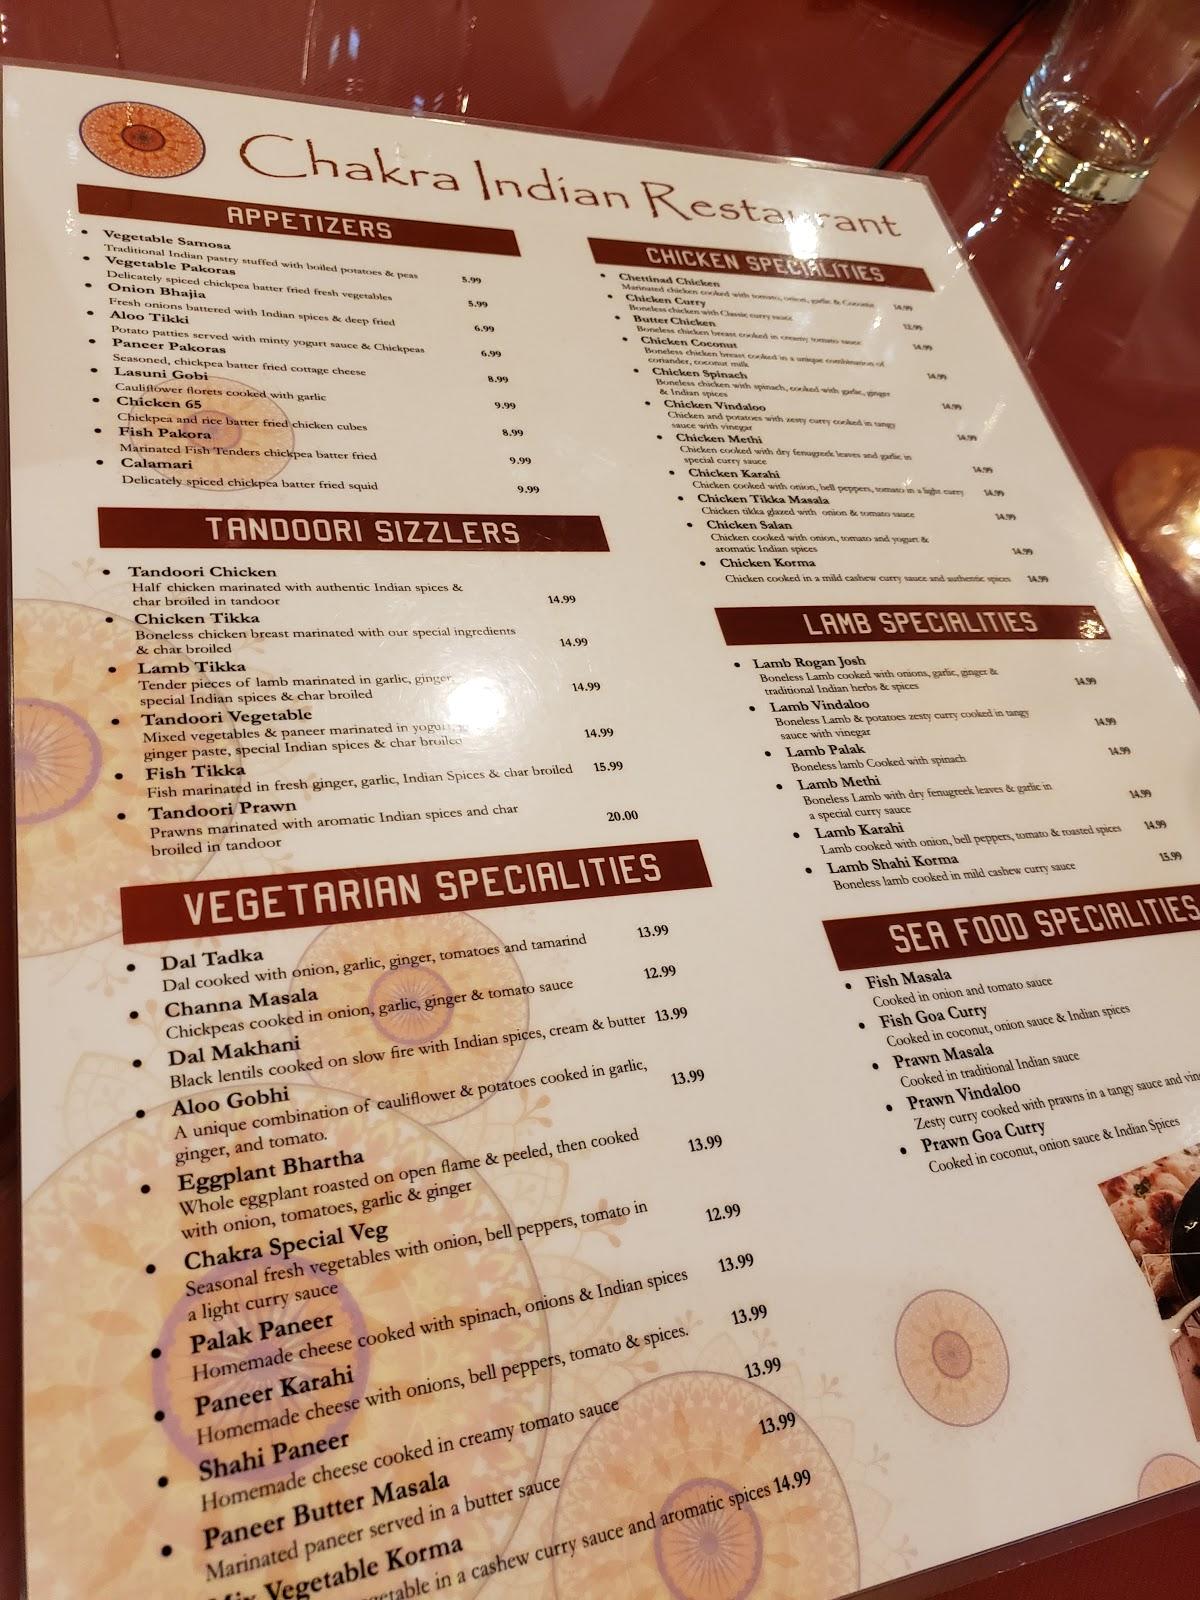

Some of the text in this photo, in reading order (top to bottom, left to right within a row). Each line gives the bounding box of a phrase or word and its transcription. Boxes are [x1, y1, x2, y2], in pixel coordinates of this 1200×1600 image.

[239, 134, 460, 192] Chakra
[474, 160, 630, 209] Indian
[226, 206, 393, 240] APPETIZERS
[104, 229, 232, 250] Vegetable Samosa
[106, 244, 165, 256] Traditional
[168, 249, 204, 260] Indian
[206, 255, 238, 265] pastry
[242, 258, 278, 267] stuffed
[280, 261, 304, 269] with
[306, 262, 338, 272] boiled
[340, 267, 383, 276] potatoes
[106, 255, 236, 275] Vegetable Pakoras
[645, 247, 885, 283] CHICKEN SPECIALITIES
[461, 275, 482, 284] 5.99
[107, 282, 206, 299] Onion Bhajia
[109, 310, 189, 324] Aloo Tikki
[112, 338, 226, 354] Paneer Pakoras
[640, 336, 738, 349] Chicken Coconut
[114, 366, 208, 381] Lasuni Gobi
[651, 367, 748, 382] Chicken Spinach
[116, 396, 202, 409] Chicken 65
[663, 399, 766, 411] Chicken Vindaloo
[119, 424, 212, 439] Fish Pakora
[675, 433, 763, 444] Chicken Methi
[120, 457, 193, 469] Calamari
[683, 455, 715, 465] special
[716, 458, 741, 466] curry
[688, 468, 781, 479] Chicken Karahi
[516, 485, 540, 494] 9.99
[697, 493, 830, 505] Chicken Tikka Masala
[205, 516, 520, 545] TANDOORI SIZZLERS
[706, 519, 793, 530] Chicken Salan
[714, 544, 818, 555] aromatic Indian spices
[127, 566, 277, 577] Tandoori Chicken
[719, 558, 816, 568] Chicken Korma
[132, 595, 280, 606] char broiled in tandoor
[547, 595, 576, 604] 14.99
[134, 612, 260, 625] Chicken Tikka
[803, 611, 1039, 636] LAMB SPECIALITIES
[137, 660, 246, 674] Lamb Tikka
[753, 655, 867, 670] Lamb Rogan Josh
[770, 699, 870, 712] Lamb Vindaloo
[140, 708, 312, 726] Tandoori Vegetable
[780, 728, 871, 740] sauce with vinegar
[786, 743, 866, 757] Lamb Palak
[145, 764, 246, 780] Fish Tikka
[797, 775, 882, 790] Lamb Methi
[147, 801, 297, 820] Tandoori Prawn
[606, 810, 639, 822] 20.00
[815, 821, 905, 839] Lamb Karahi
[827, 855, 960, 874] Lamb Shahi Korma
[183, 853, 662, 925] VEGETARIAN SPECIALITIES
[636, 924, 669, 938] 13.99
[888, 894, 1200, 954] SEA FOOD SPECIALITIES
[161, 948, 264, 971] Dal Tadka
[643, 964, 676, 979] 12.99
[866, 968, 952, 989] Fish Masala
[872, 978, 1053, 1007] Cooked in onion and tomato sauce
[164, 988, 319, 1018] Channa Masala
[880, 1005, 987, 1028] Fish Goa Curry
[168, 1035, 301, 1066] Dal Makhani
[894, 1043, 994, 1069] Prawn Masala
[171, 1085, 290, 1117] Aloo Gobhi
[907, 1082, 1021, 1110] Prawn Vindaloo
[921, 1122, 1045, 1153] Prawn Goa Curry
[175, 1131, 327, 1167] ginger, and tomato.
[177, 1150, 365, 1194] Eggplant Bhartha
[184, 1222, 389, 1270] Chakra Special Veg
[191, 1315, 334, 1354] Palak Paneer
[195, 1367, 355, 1416] Paneer Karahi
[198, 1433, 349, 1481] Shahi Paneer
[773, 1470, 812, 1494] 14.99
[204, 1472, 450, 1549] Paneer Butter Masala
[264, 1538, 464, 1600] Vegetable Korma
